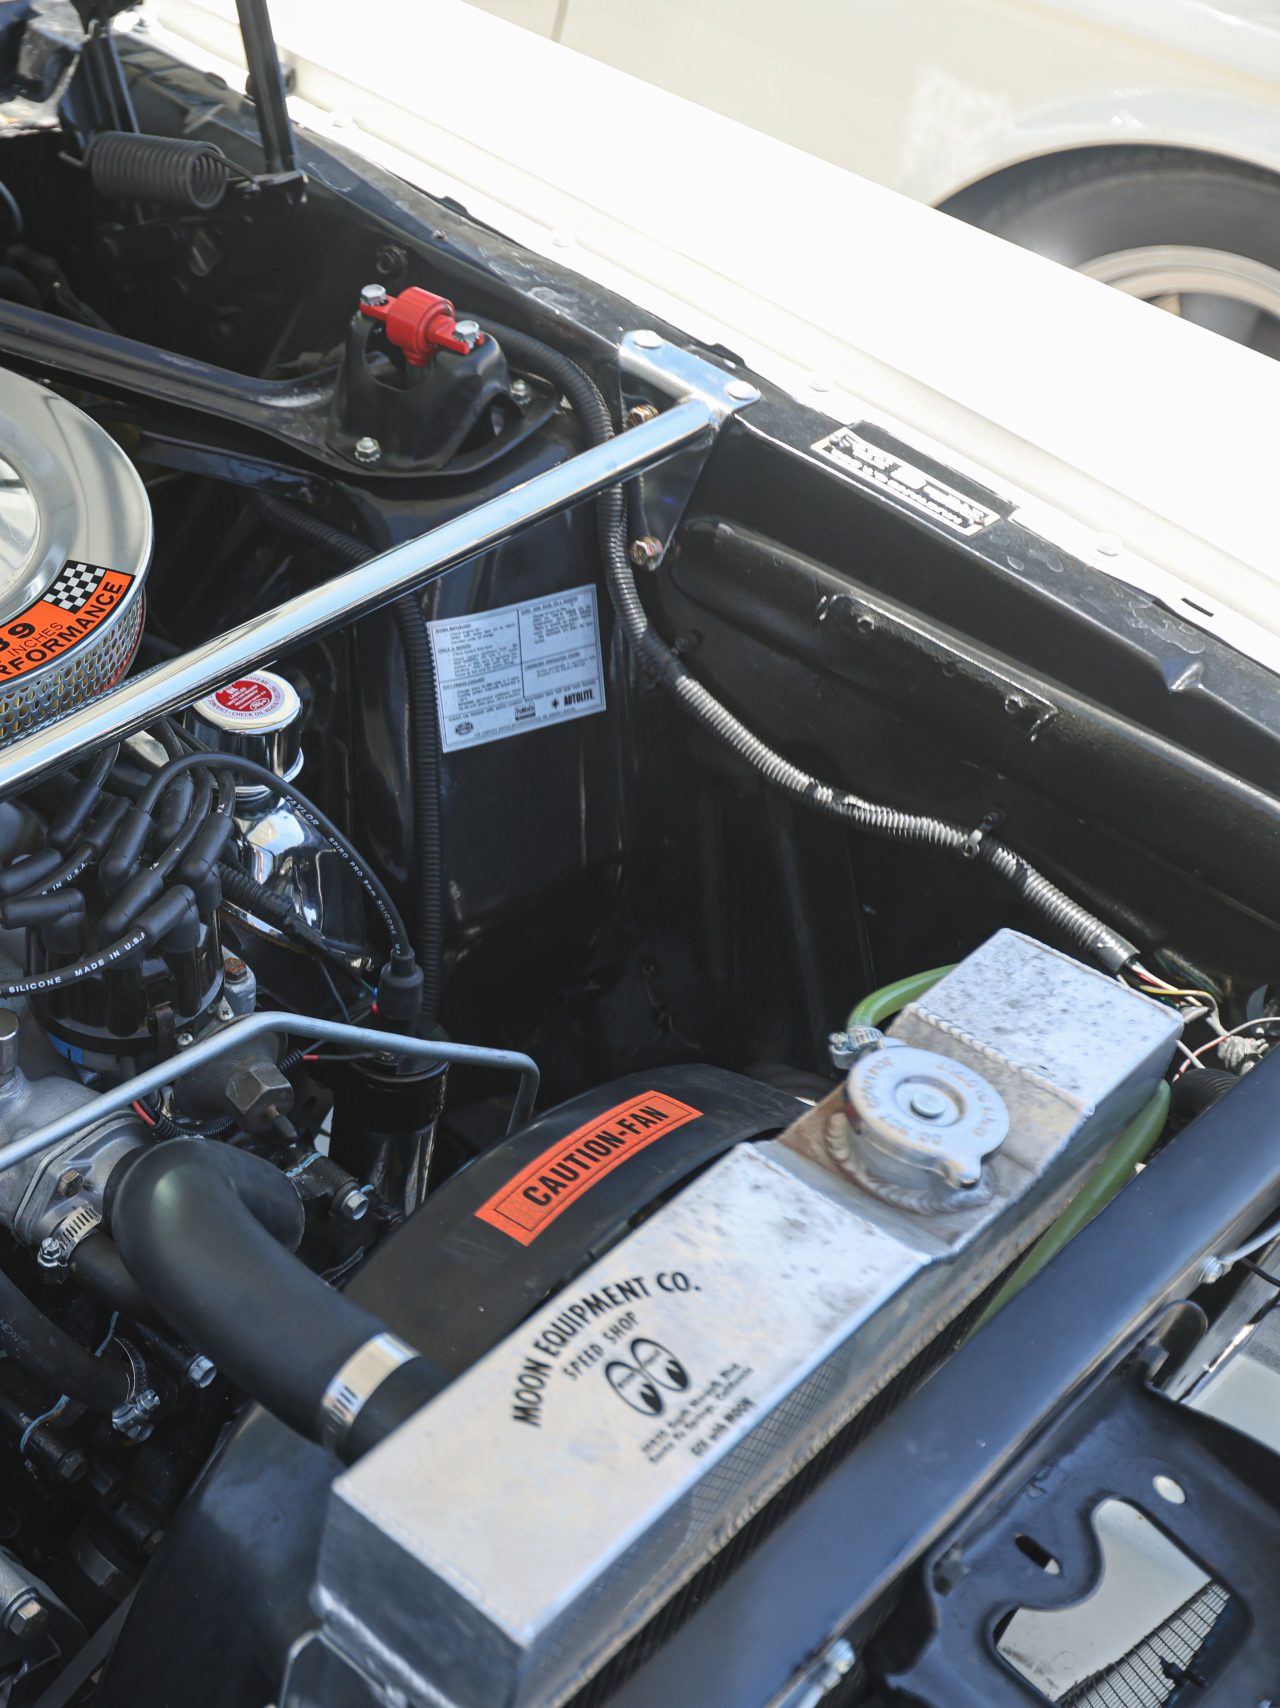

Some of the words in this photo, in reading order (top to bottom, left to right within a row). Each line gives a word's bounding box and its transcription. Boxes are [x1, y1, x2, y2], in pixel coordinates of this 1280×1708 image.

[7, 621, 64, 657] INCHES
[563, 689, 594, 707] AUTOLITE
[52, 880, 62, 891] IN
[284, 794, 320, 826] TAYLOR
[328, 836, 349, 859] SPIRO
[376, 899, 398, 936] SILICONE
[8, 976, 62, 994] SILICONE
[74, 958, 105, 977] MADE
[109, 949, 120, 961] IN
[522, 1105, 670, 1207] CAUTION-FAN
[512, 1357, 552, 1429] MOON
[533, 1276, 652, 1357] EQUIPMENT
[656, 1271, 702, 1293] CO.
[563, 1343, 605, 1381] SPEED
[602, 1311, 640, 1345] SHOP
